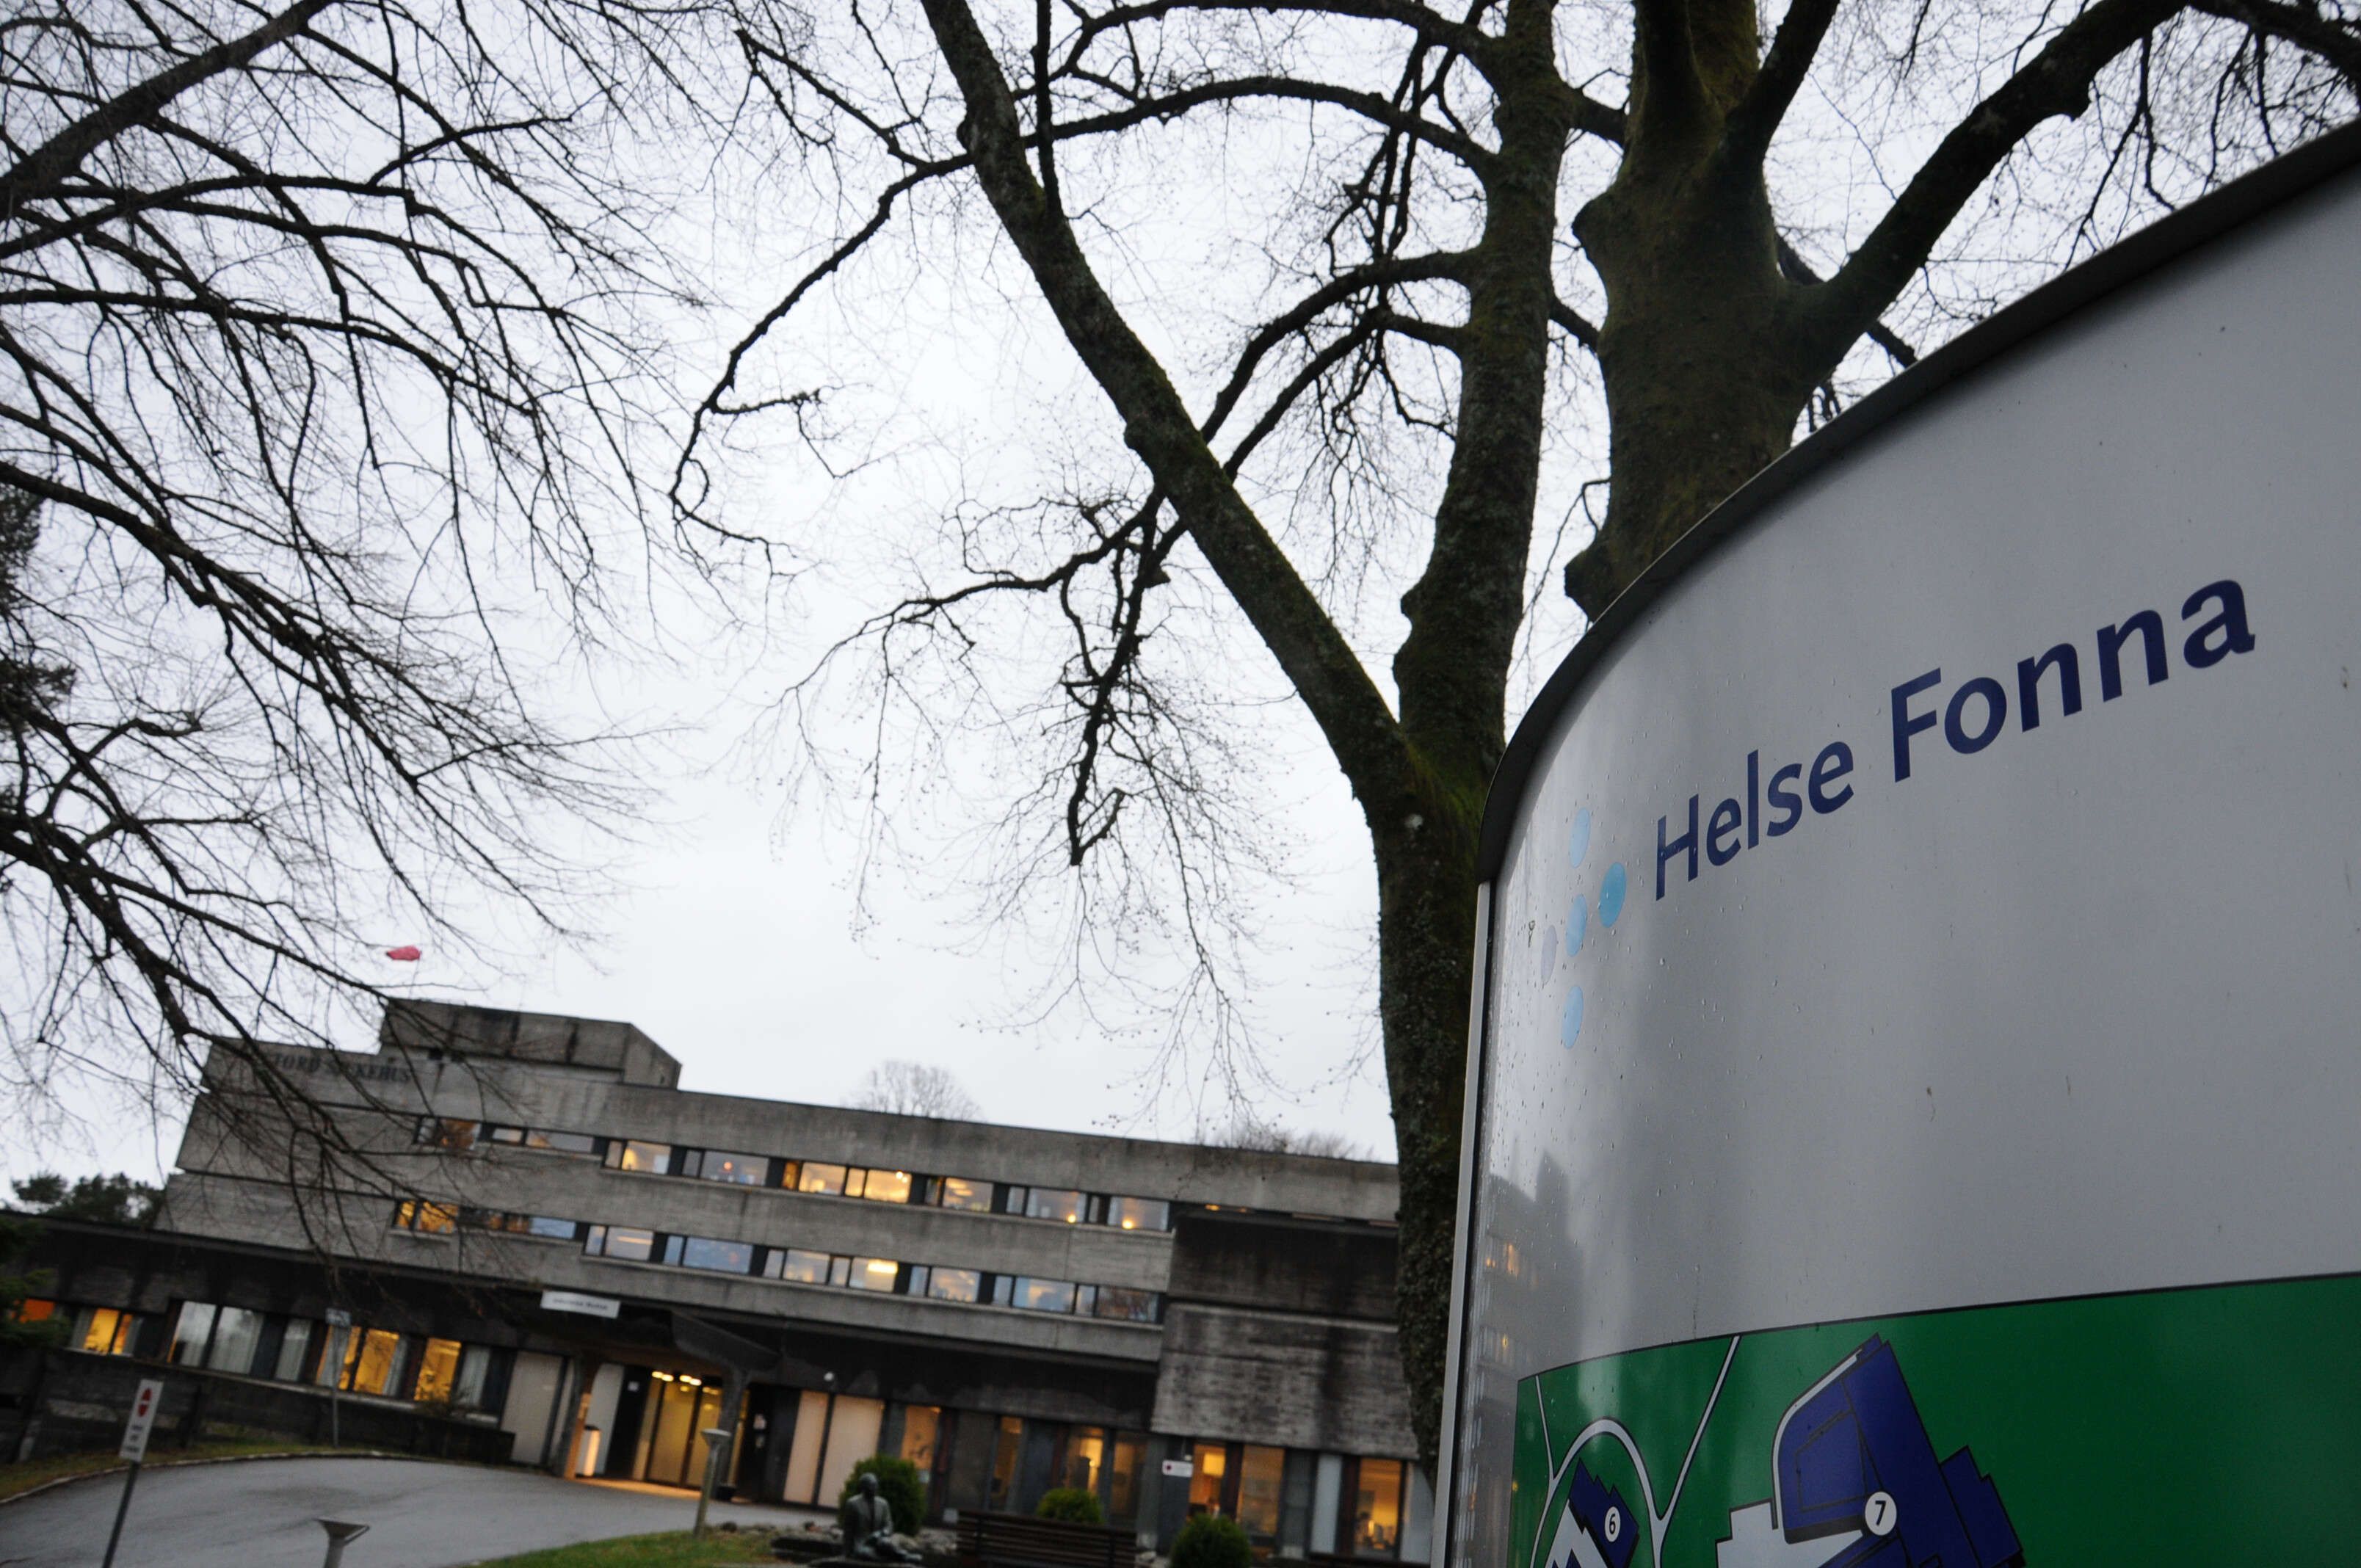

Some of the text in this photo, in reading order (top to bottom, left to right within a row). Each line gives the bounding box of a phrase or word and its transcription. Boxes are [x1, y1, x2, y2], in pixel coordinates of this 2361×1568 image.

[1655, 578, 2256, 901] Helse Fonna
[1609, 1513, 1617, 1535] 6
[1875, 1500, 1887, 1526] 7
